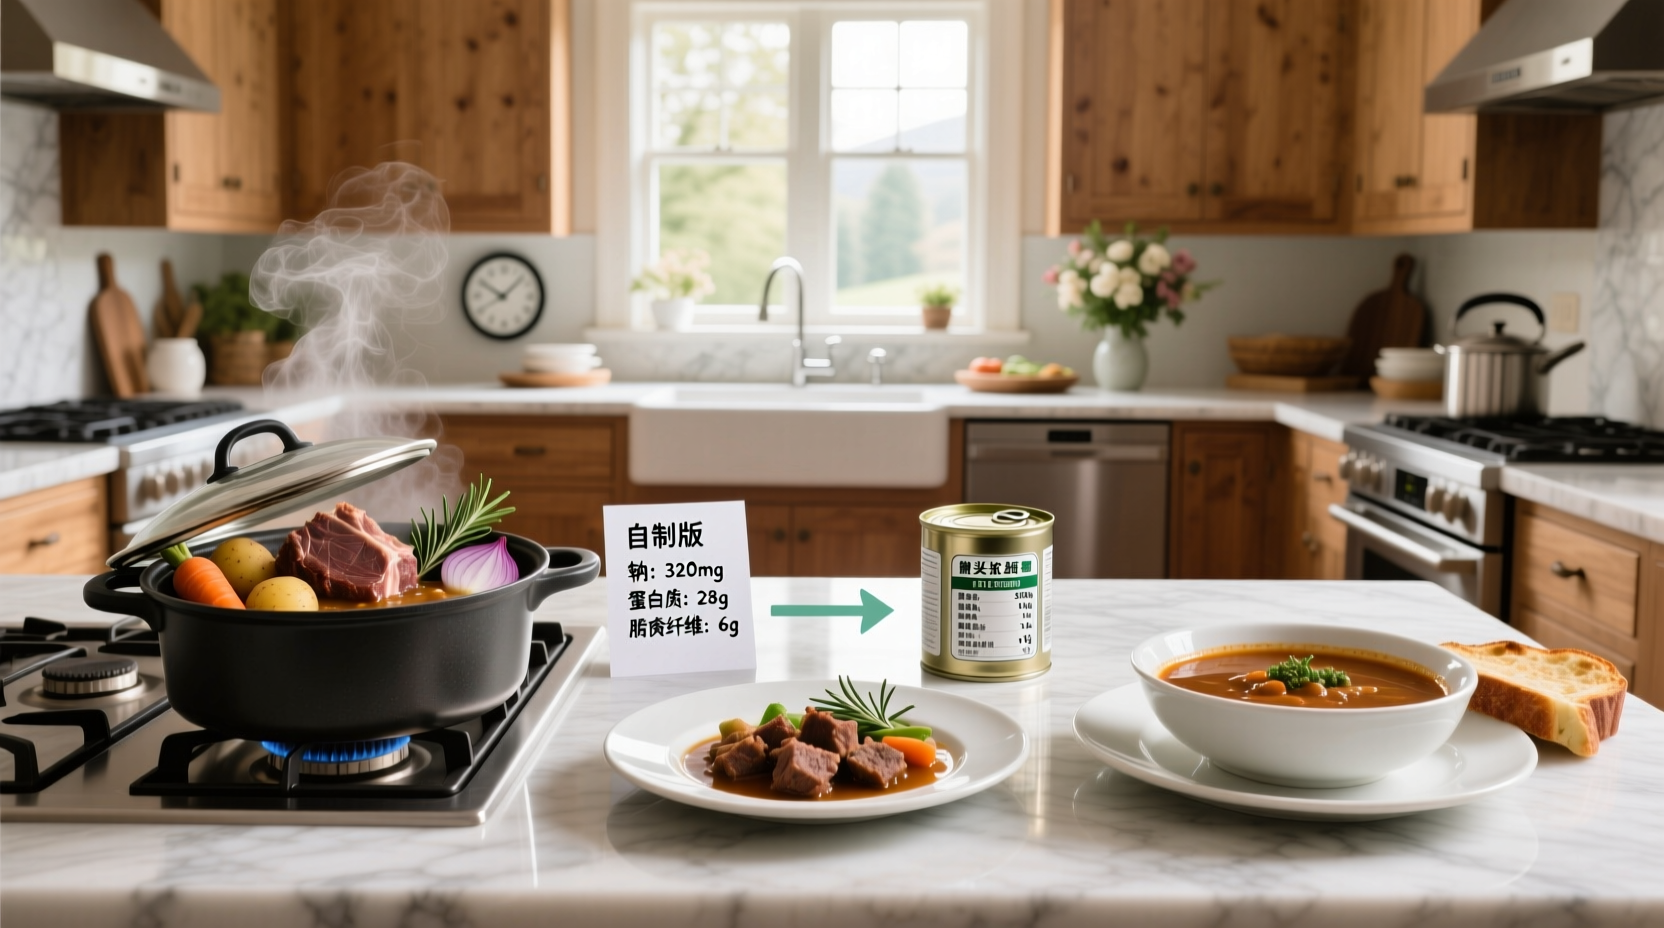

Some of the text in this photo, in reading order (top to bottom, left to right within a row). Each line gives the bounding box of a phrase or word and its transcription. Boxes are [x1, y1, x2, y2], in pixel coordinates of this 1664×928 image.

[628, 521, 704, 550] 自制版
[665, 561, 724, 583] 320mg
[696, 589, 729, 611] 28g
[718, 616, 739, 638] 6g
